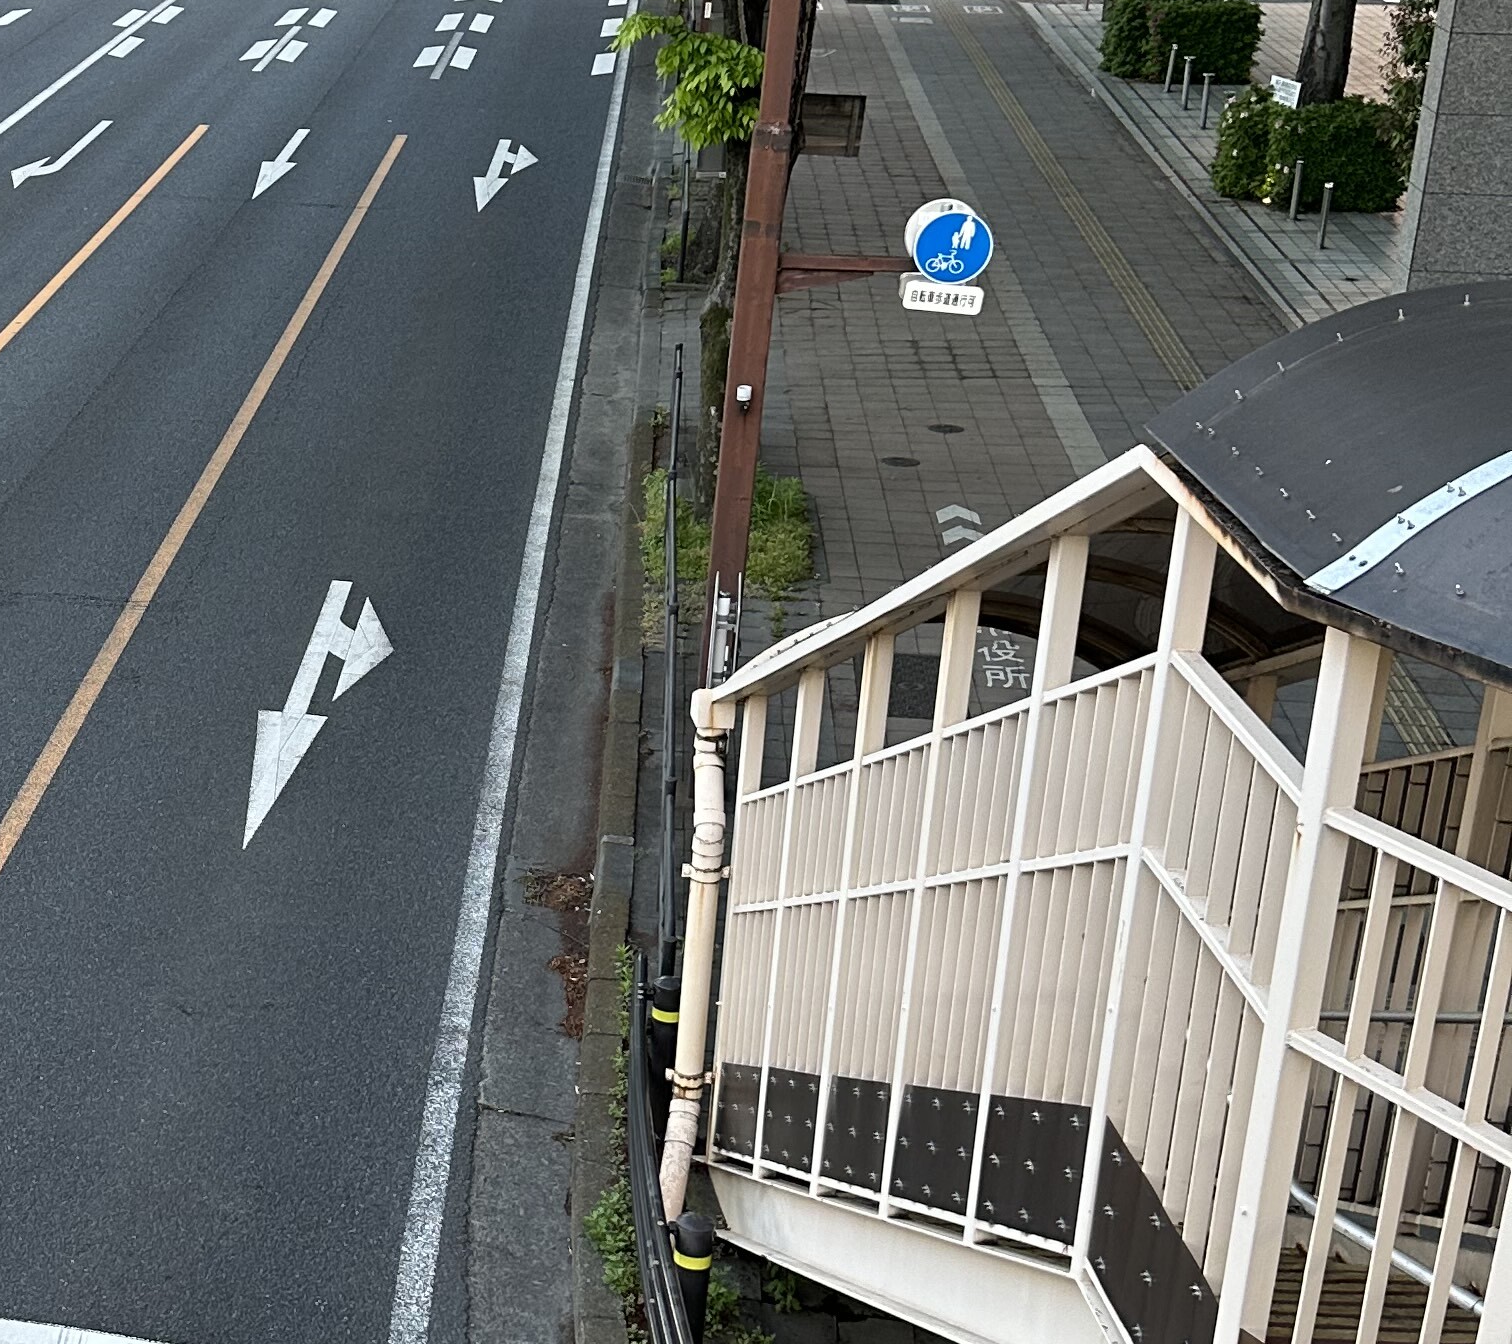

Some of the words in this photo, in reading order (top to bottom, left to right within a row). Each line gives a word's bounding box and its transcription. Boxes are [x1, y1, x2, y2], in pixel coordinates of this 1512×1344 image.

[910, 289, 977, 308] 自転車歩道通行可
